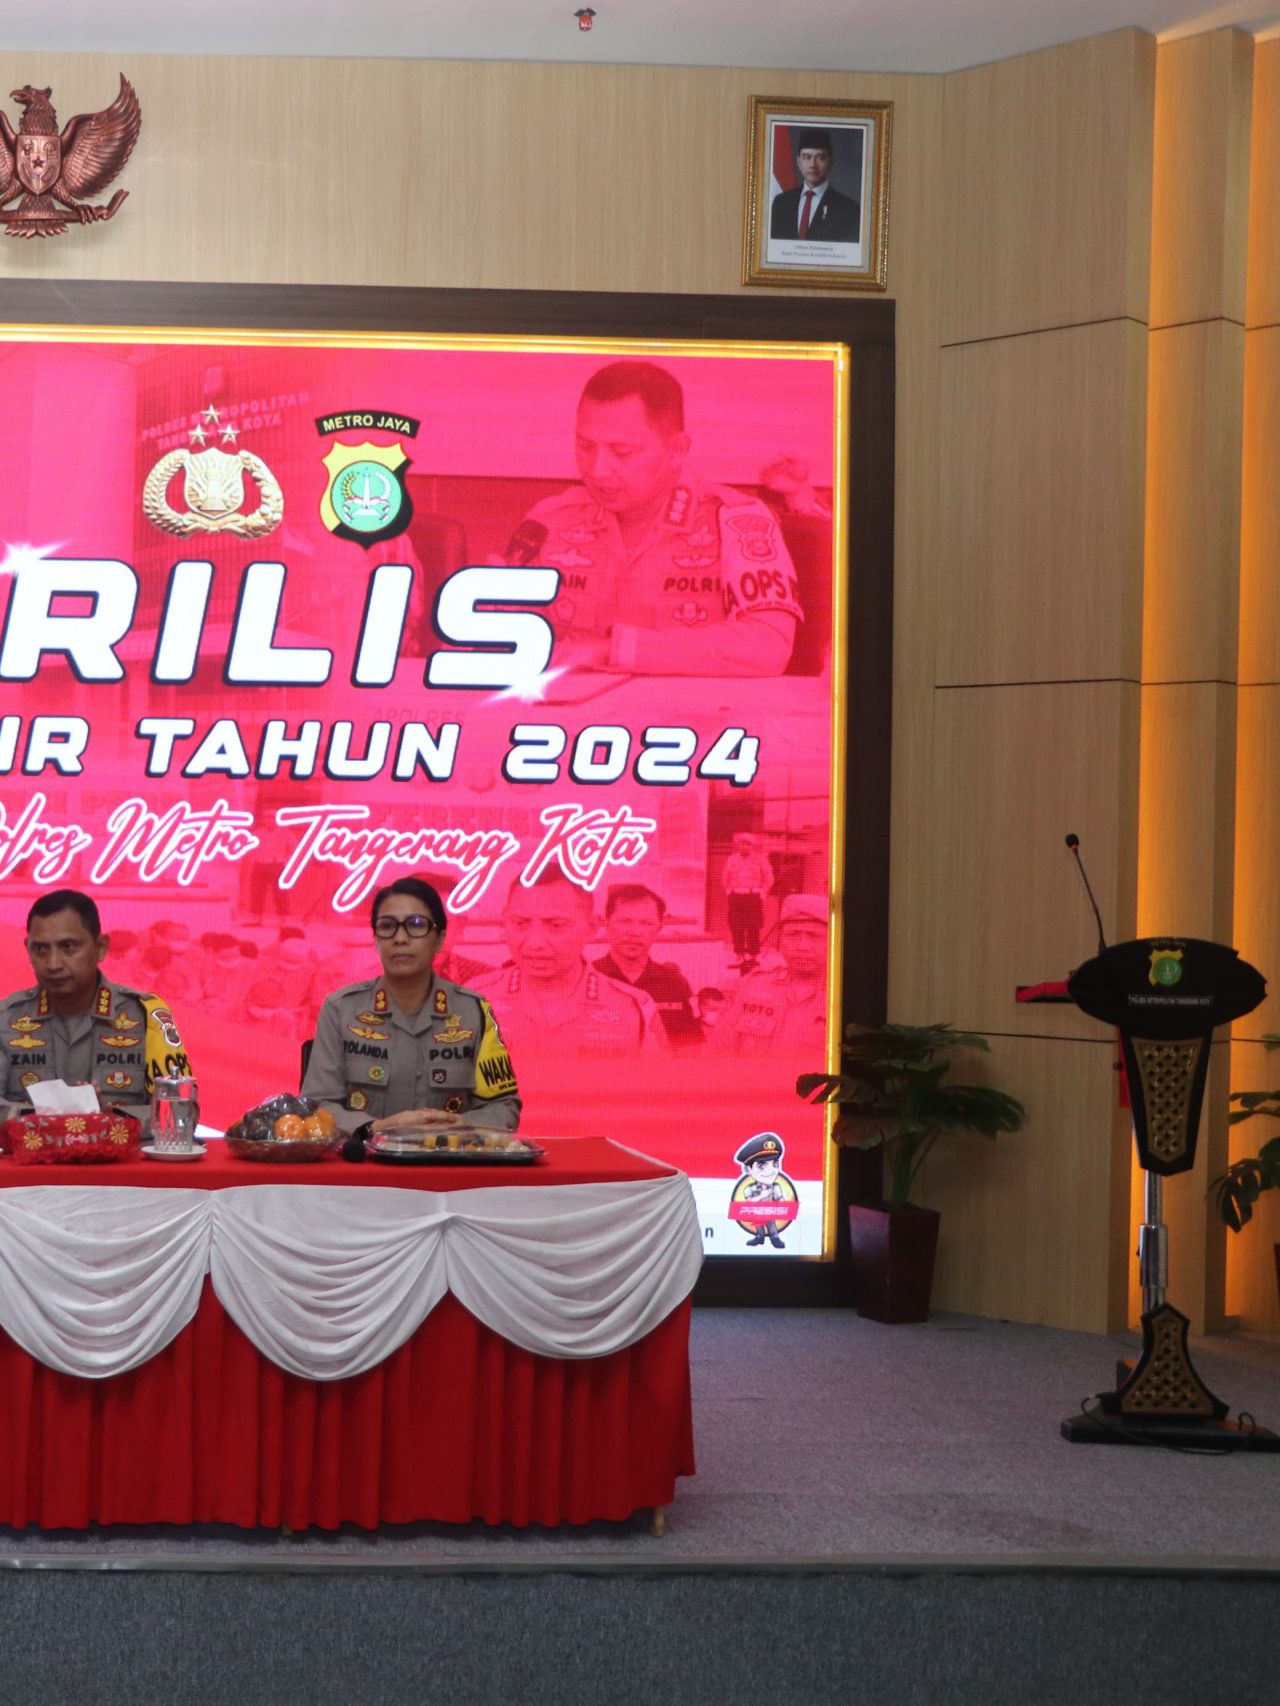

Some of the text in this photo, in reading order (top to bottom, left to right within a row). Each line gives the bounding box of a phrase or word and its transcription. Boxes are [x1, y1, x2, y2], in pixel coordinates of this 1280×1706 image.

[323, 414, 411, 434] METRO JAYA
[664, 576, 721, 592] POLRI
[740, 570, 787, 602] OPS
[135, 718, 461, 783] TAHUN
[503, 722, 761, 788] 2024
[90, 797, 260, 886] Metro
[276, 805, 521, 913] Tangerang
[519, 802, 657, 891] Kota
[742, 1003, 774, 1017] TOTO
[10, 1053, 47, 1066] ZAIN
[96, 1052, 142, 1066] POLRI
[344, 1040, 389, 1061] YOLANDA
[429, 1045, 476, 1061] POLRI
